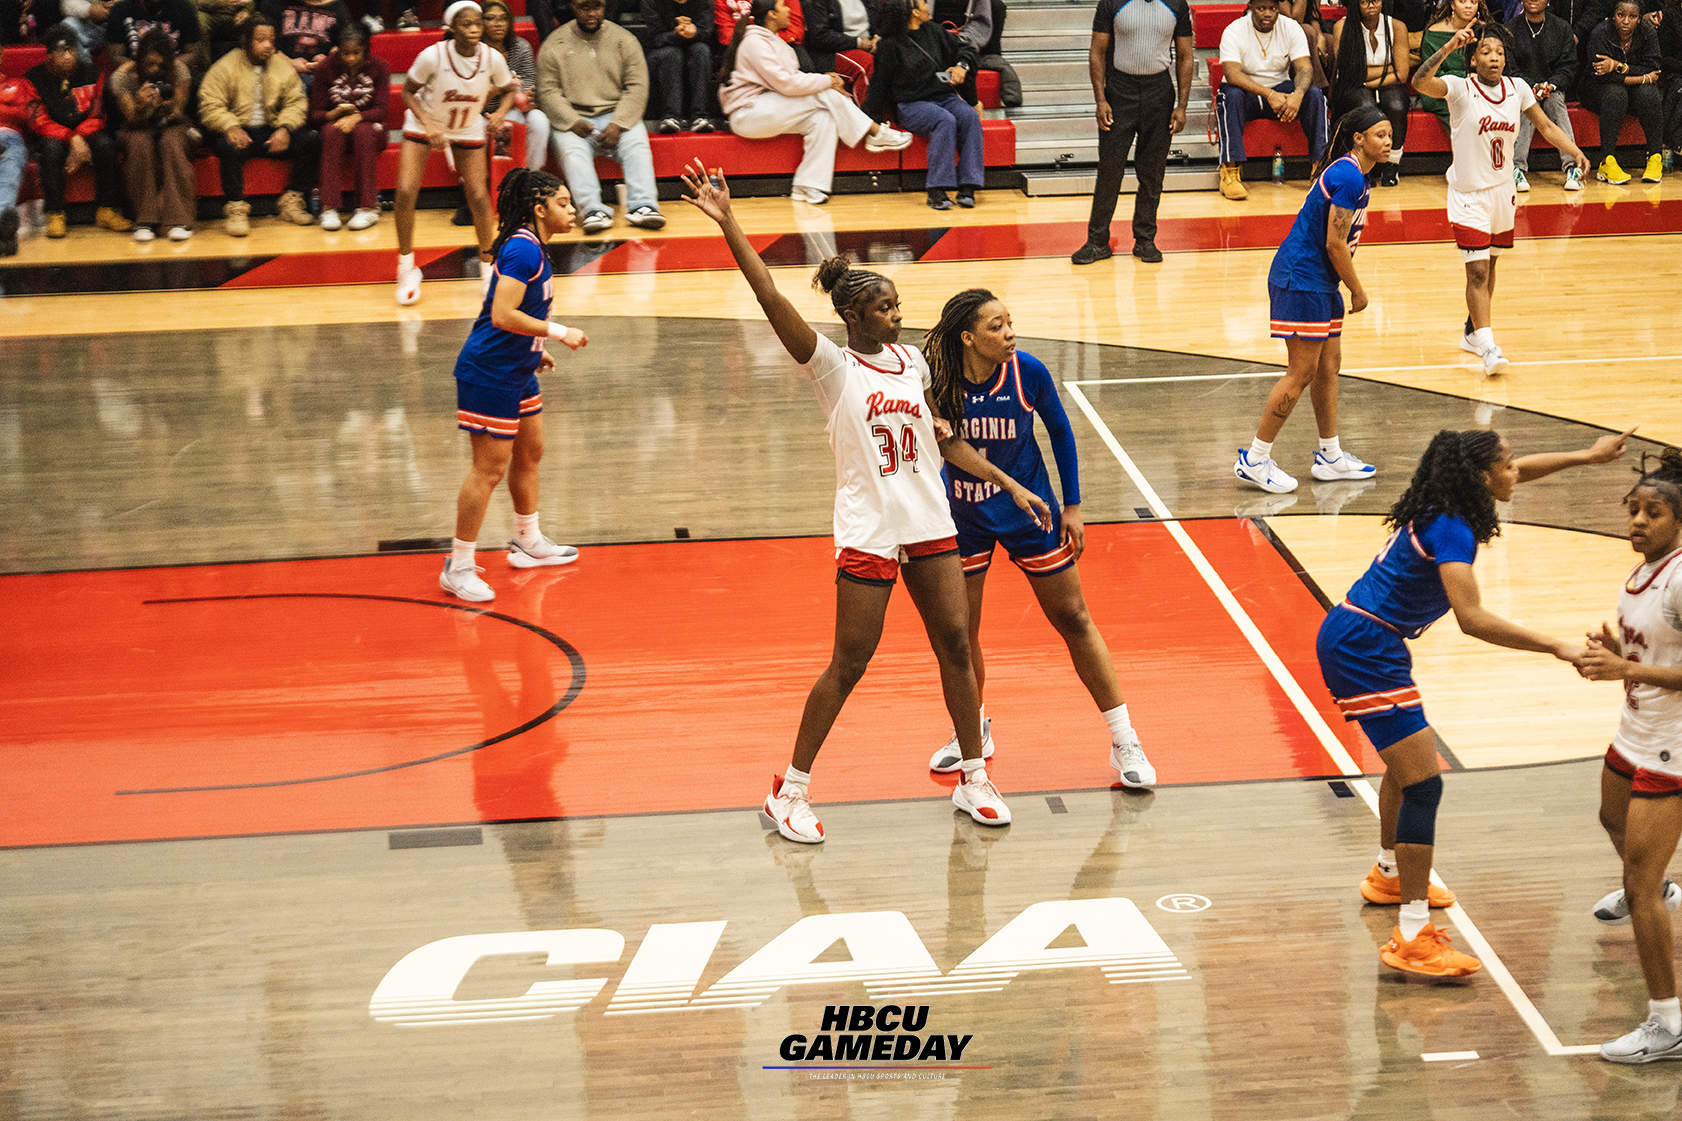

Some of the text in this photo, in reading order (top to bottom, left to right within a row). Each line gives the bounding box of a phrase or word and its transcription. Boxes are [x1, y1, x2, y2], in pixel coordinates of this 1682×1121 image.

[447, 106, 470, 129] 11
[1478, 115, 1516, 135] Rams
[1490, 137, 1505, 171] 0
[866, 391, 922, 421] Rams
[960, 416, 1017, 440] RGINIA
[872, 422, 920, 477] 34
[369, 896, 1193, 1027] CIAA
